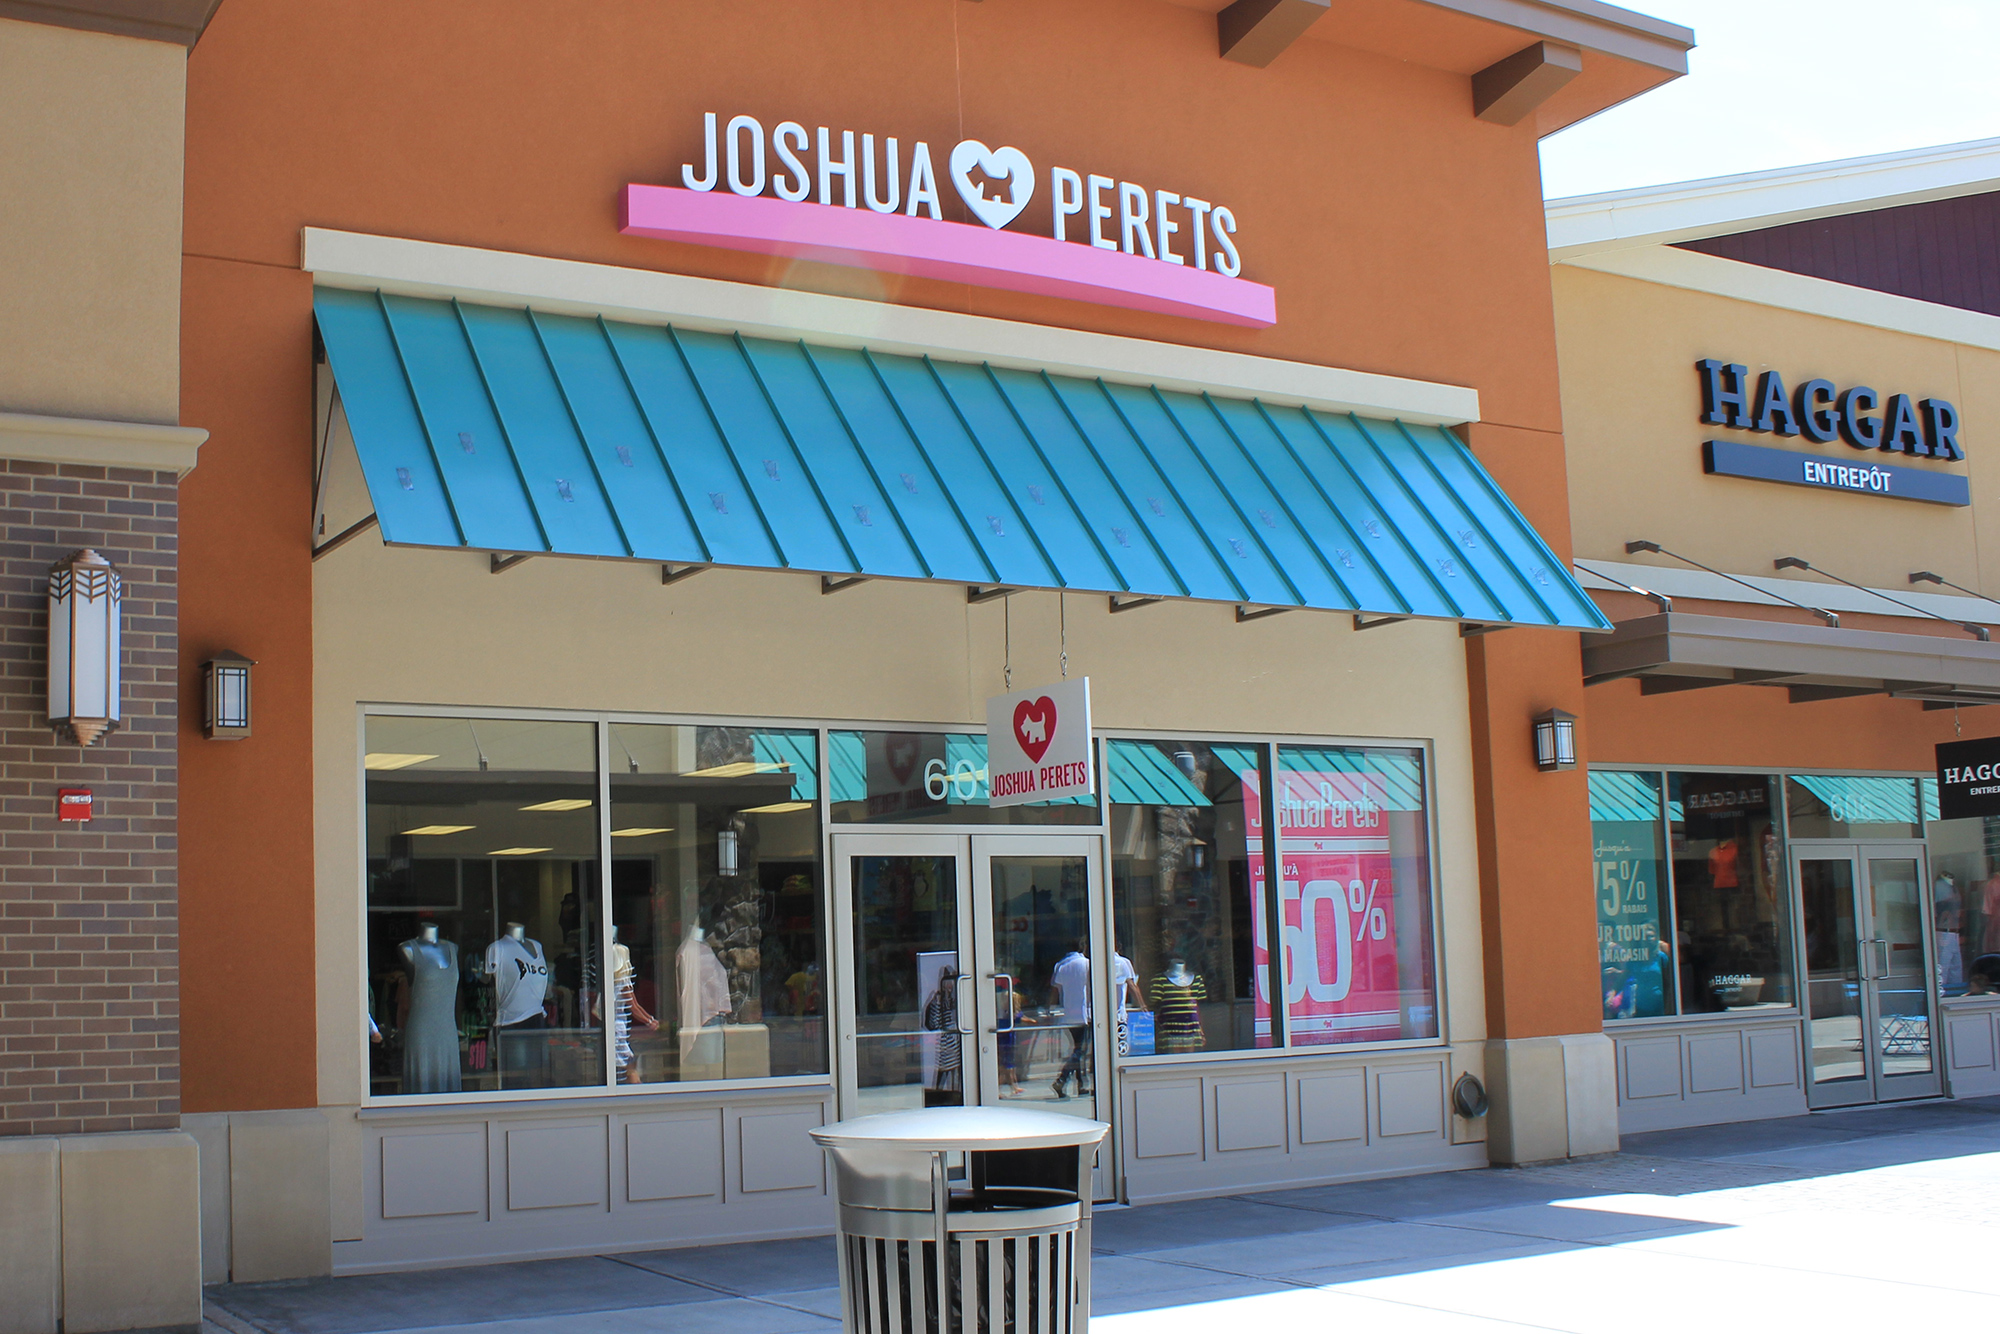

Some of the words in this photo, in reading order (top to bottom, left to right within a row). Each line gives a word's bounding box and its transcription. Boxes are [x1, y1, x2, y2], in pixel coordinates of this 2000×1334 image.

[681, 111, 943, 221] JOSHUA
[1051, 165, 1242, 278] PERETS
[1696, 358, 1965, 462] HAGGAR
[1803, 460, 1892, 492] ENTREPÔT
[923, 757, 989, 801] 60
[991, 769, 1036, 798] JOSHUA
[1040, 761, 1086, 790] PERETS
[1603, 948, 1649, 963] MAGASIN
[1714, 973, 1752, 985] HAGGAR
